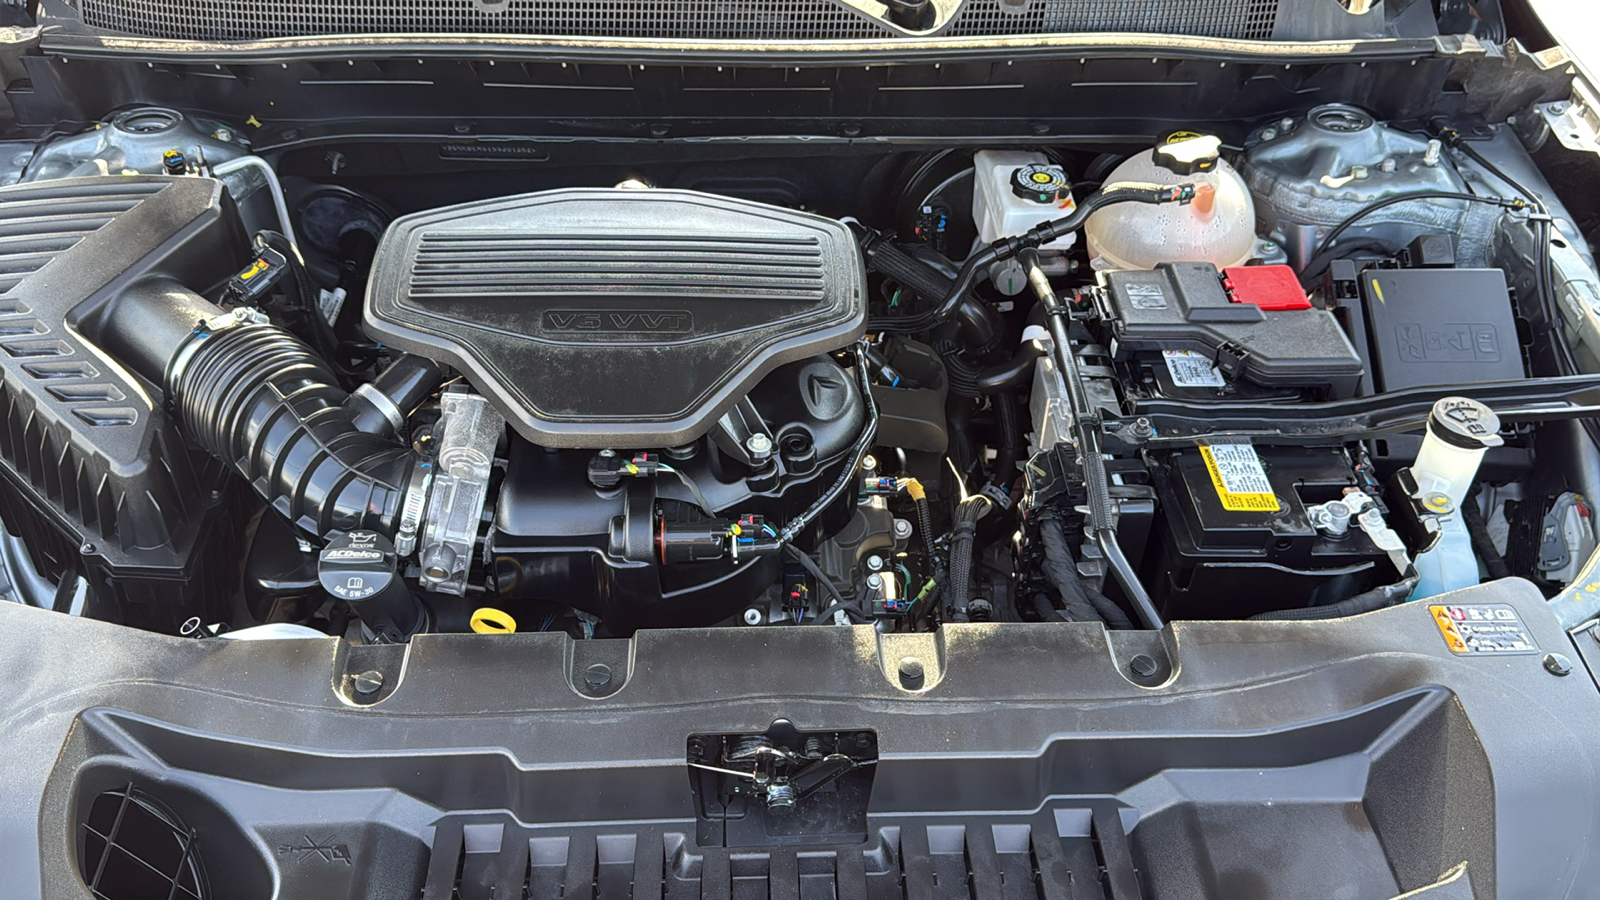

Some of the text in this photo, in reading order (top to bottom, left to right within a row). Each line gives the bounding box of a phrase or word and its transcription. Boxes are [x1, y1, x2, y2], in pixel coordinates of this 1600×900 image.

[549, 313, 687, 329] V6 VVT
[324, 550, 380, 559] ACDelco
[334, 585, 374, 597] SAE 5W-30
